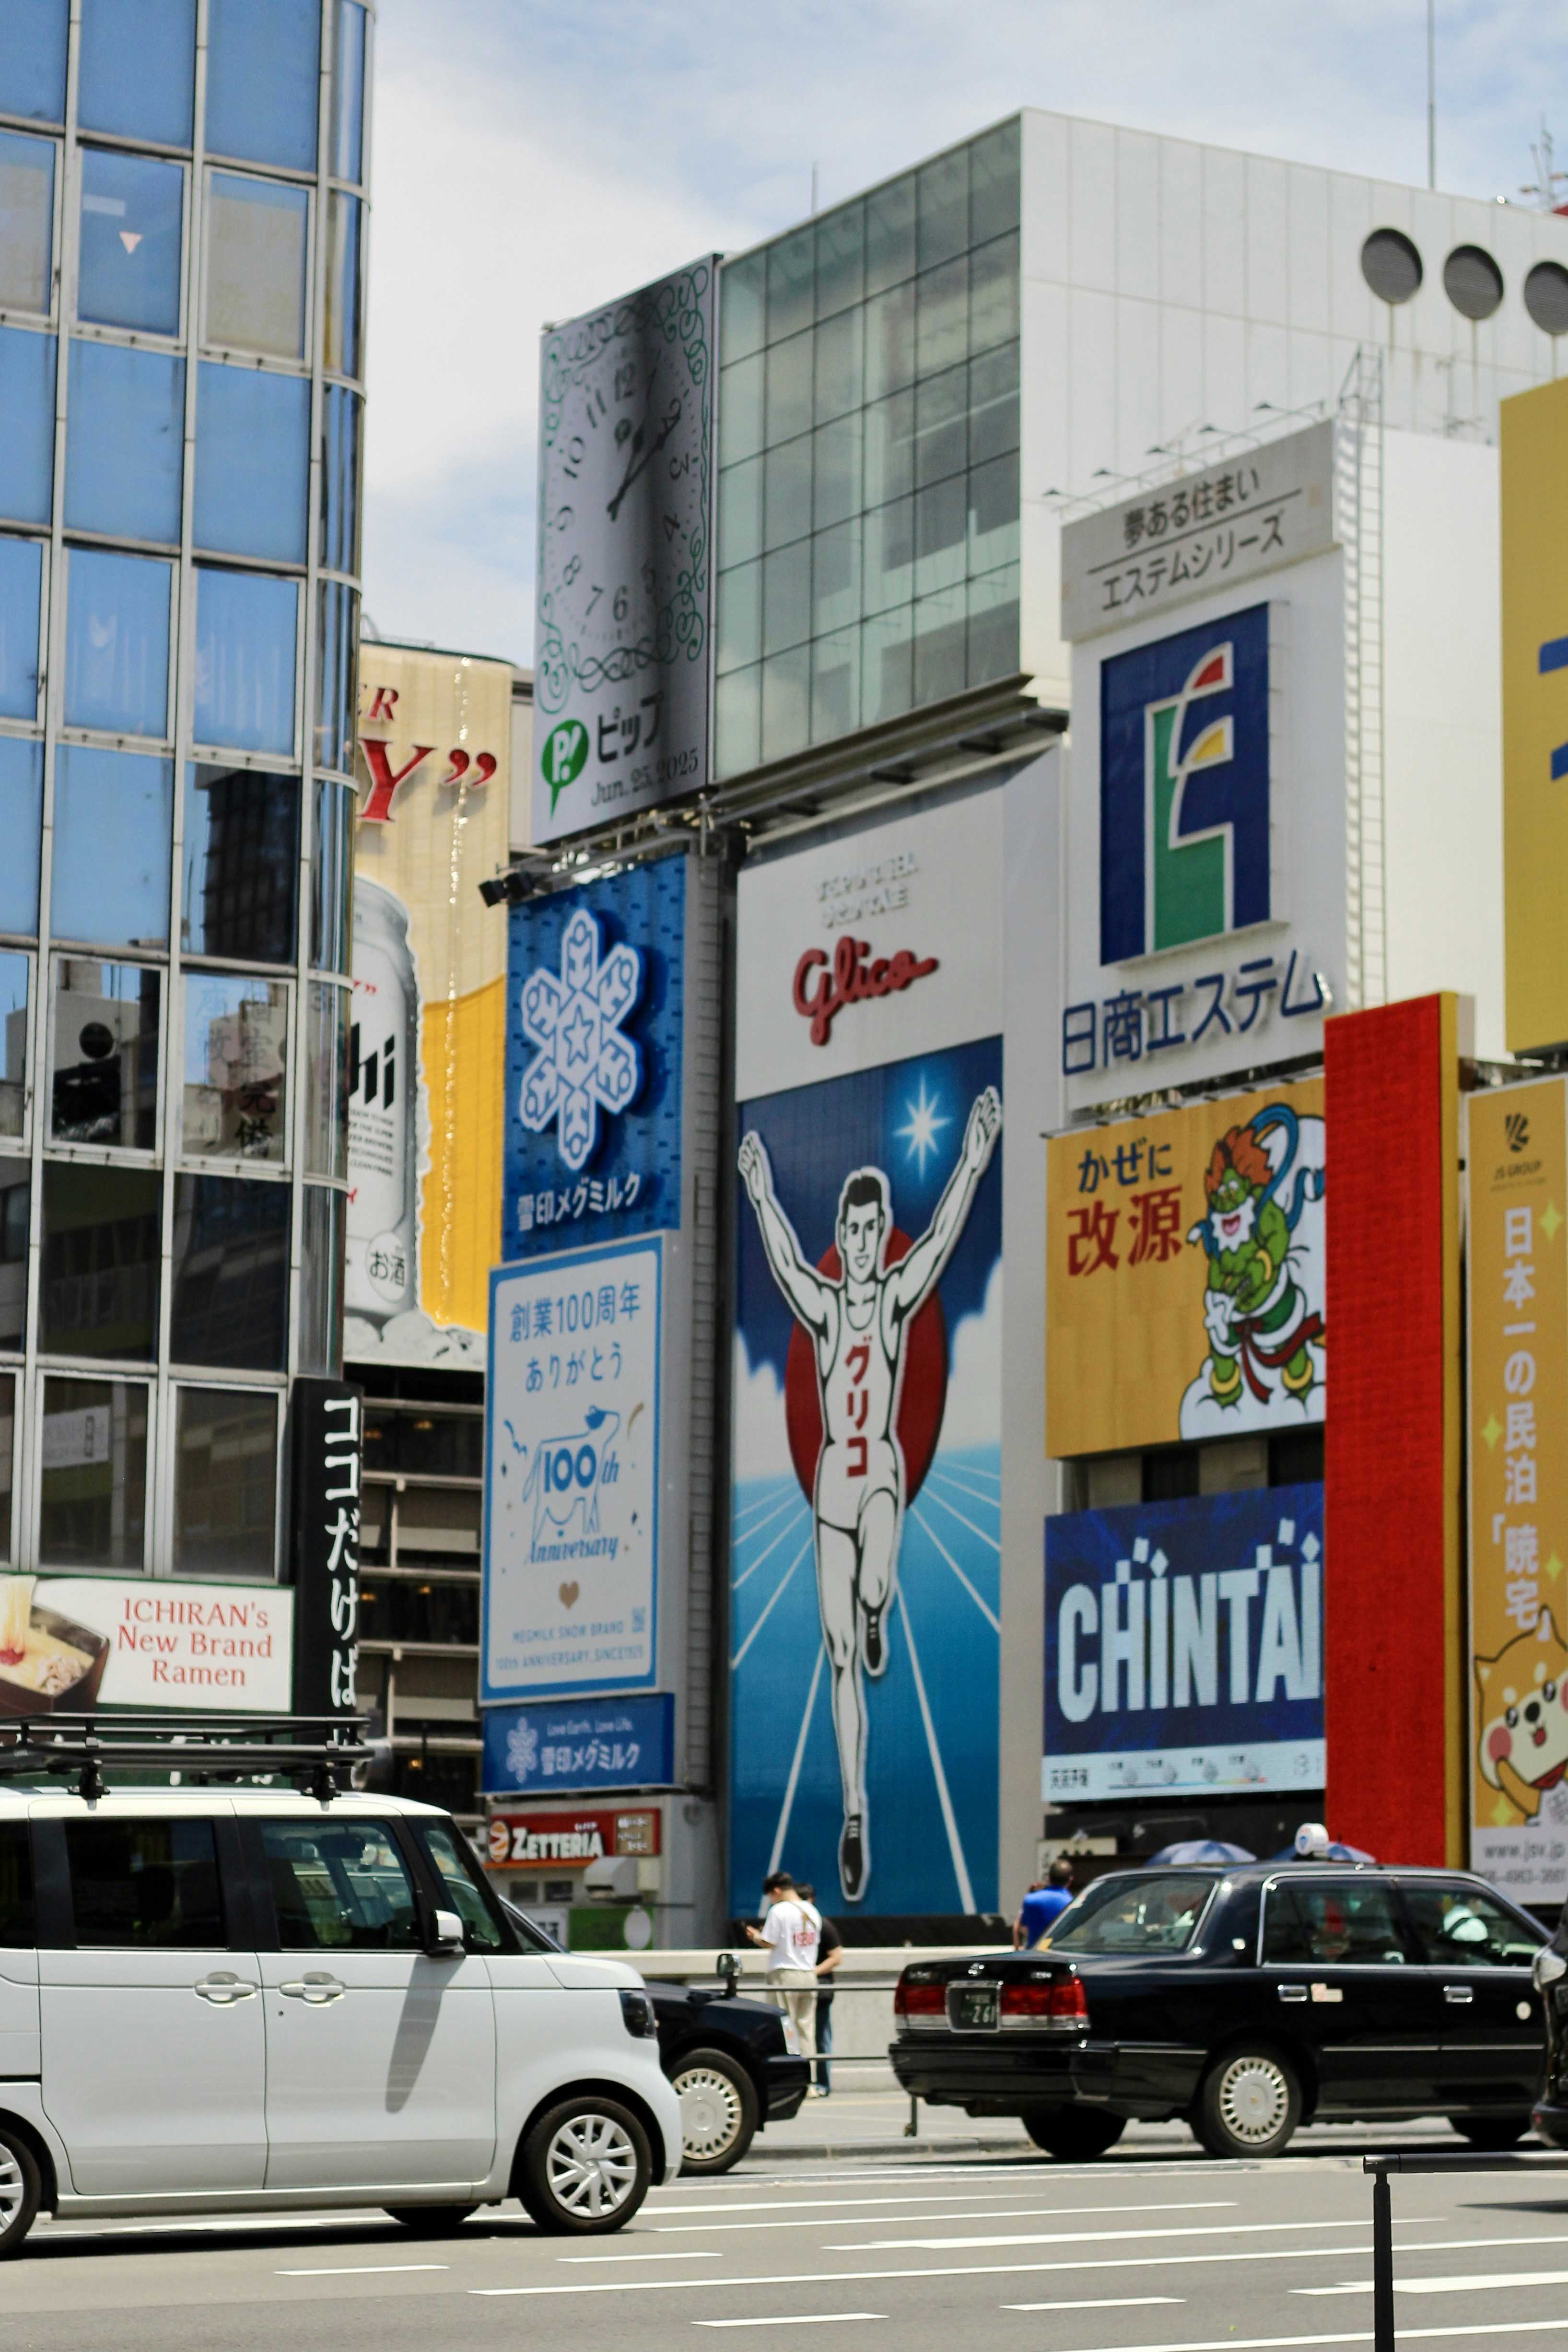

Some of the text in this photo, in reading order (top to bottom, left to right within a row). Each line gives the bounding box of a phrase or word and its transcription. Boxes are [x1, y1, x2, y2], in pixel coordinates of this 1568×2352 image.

[562, 554, 584, 586] 8
[1101, 509, 1287, 610] エステムシリーズ
[585, 585, 605, 618] 7
[612, 585, 628, 621] 6
[597, 691, 664, 763] ピップ
[793, 935, 940, 1047] Glico
[1063, 948, 1329, 1076] 日商エステム
[1078, 1136, 1172, 1193] かぜに
[517, 1171, 641, 1231] 雪印メグミルク
[1067, 1185, 1182, 1277] 改源
[370, 1251, 404, 1287] お酒
[510, 1281, 641, 1342] 創業100周年
[525, 1341, 622, 1392] ありがとう
[844, 1334, 873, 1478] グリコ
[524, 1536, 619, 1565] Anniversary
[123, 1597, 269, 1629] ICHIRAN's
[1058, 1525, 1321, 1722] CHINTAI
[118, 1625, 273, 1659] New Brand
[152, 1659, 246, 1687] Ramen
[541, 1738, 640, 1776] 雪印メグミルク
[511, 1826, 604, 1860] ZETTERIA
